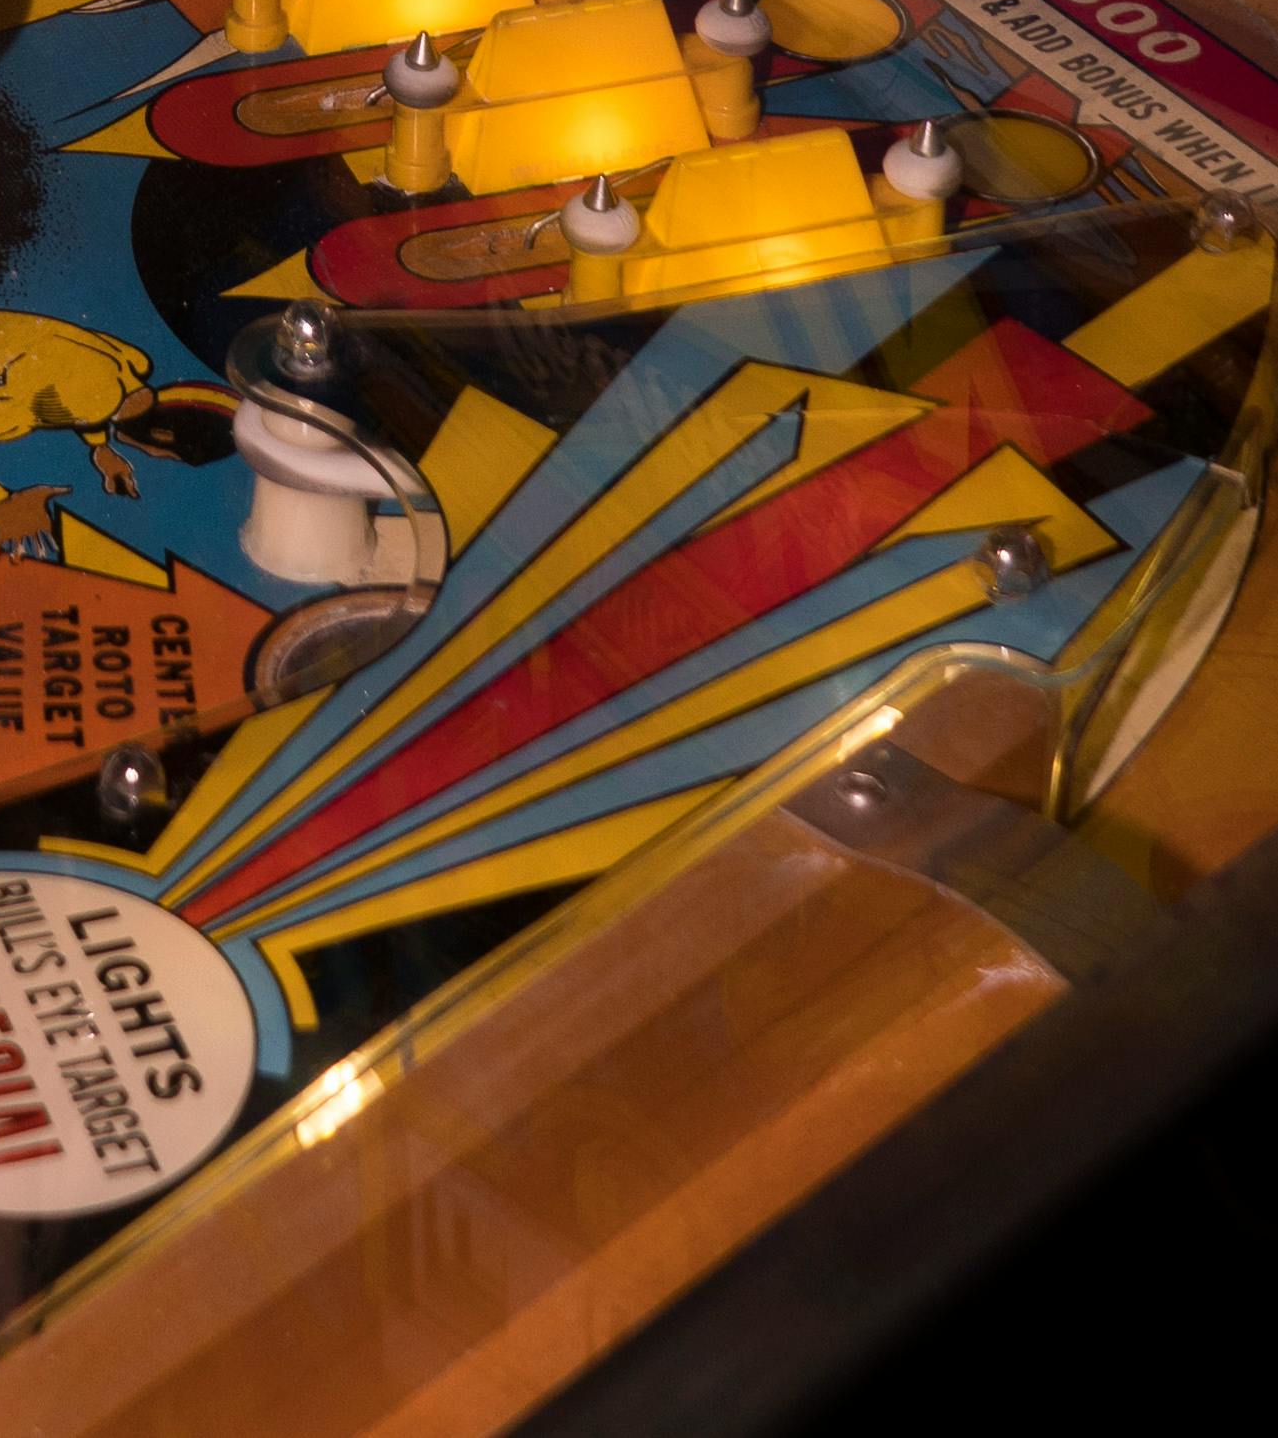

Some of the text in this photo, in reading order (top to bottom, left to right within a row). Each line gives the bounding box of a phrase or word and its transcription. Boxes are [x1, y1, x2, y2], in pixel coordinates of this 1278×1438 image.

[1010, 12, 1074, 55] ADD
[1058, 52, 1170, 122] BONUS
[1154, 118, 1256, 185] WHEN
[41, 603, 85, 748] TARGET
[91, 624, 135, 720] ROTO
[150, 613, 198, 730] CENTE
[24, 979, 101, 1046] EYE
[66, 905, 203, 1100] LIGHTS
[56, 1045, 161, 1175] TARGET
